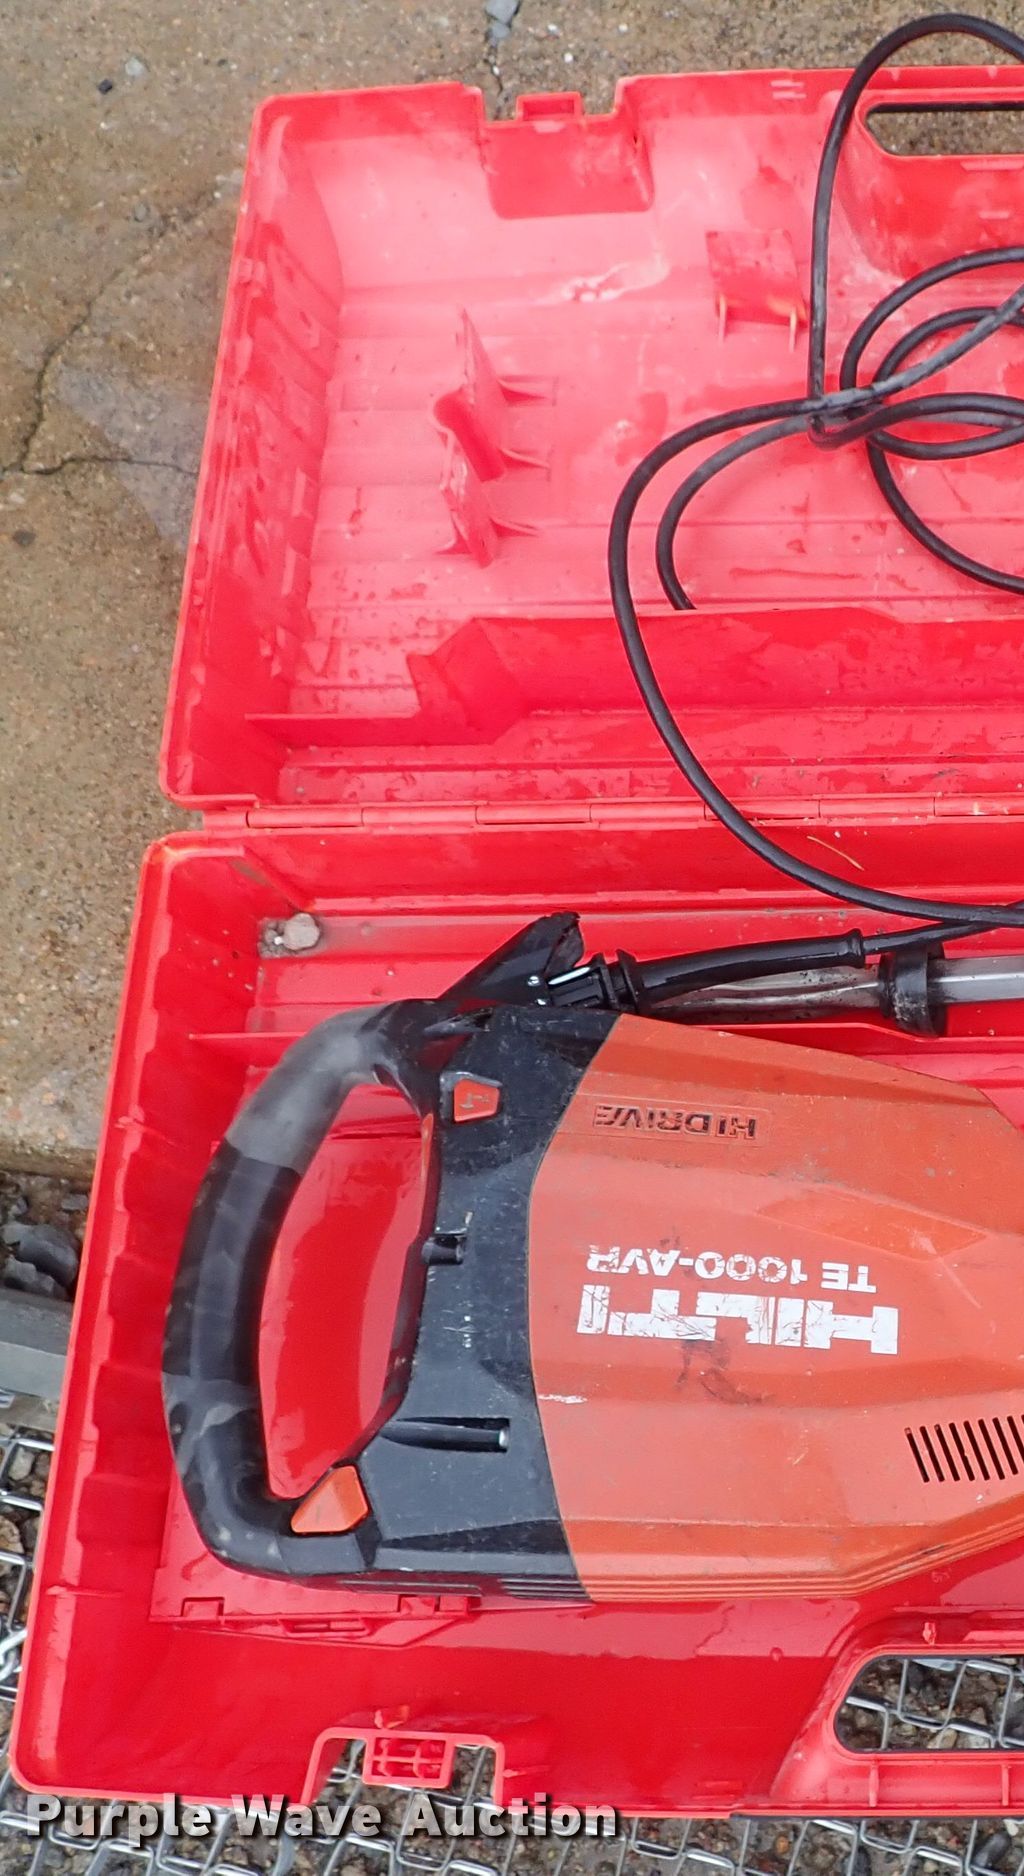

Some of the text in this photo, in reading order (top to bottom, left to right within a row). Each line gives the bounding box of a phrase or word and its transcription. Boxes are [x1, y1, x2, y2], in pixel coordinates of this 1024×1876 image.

[586, 1245, 877, 1293] TE 1000-AVR
[577, 1284, 898, 1354] HILTI
